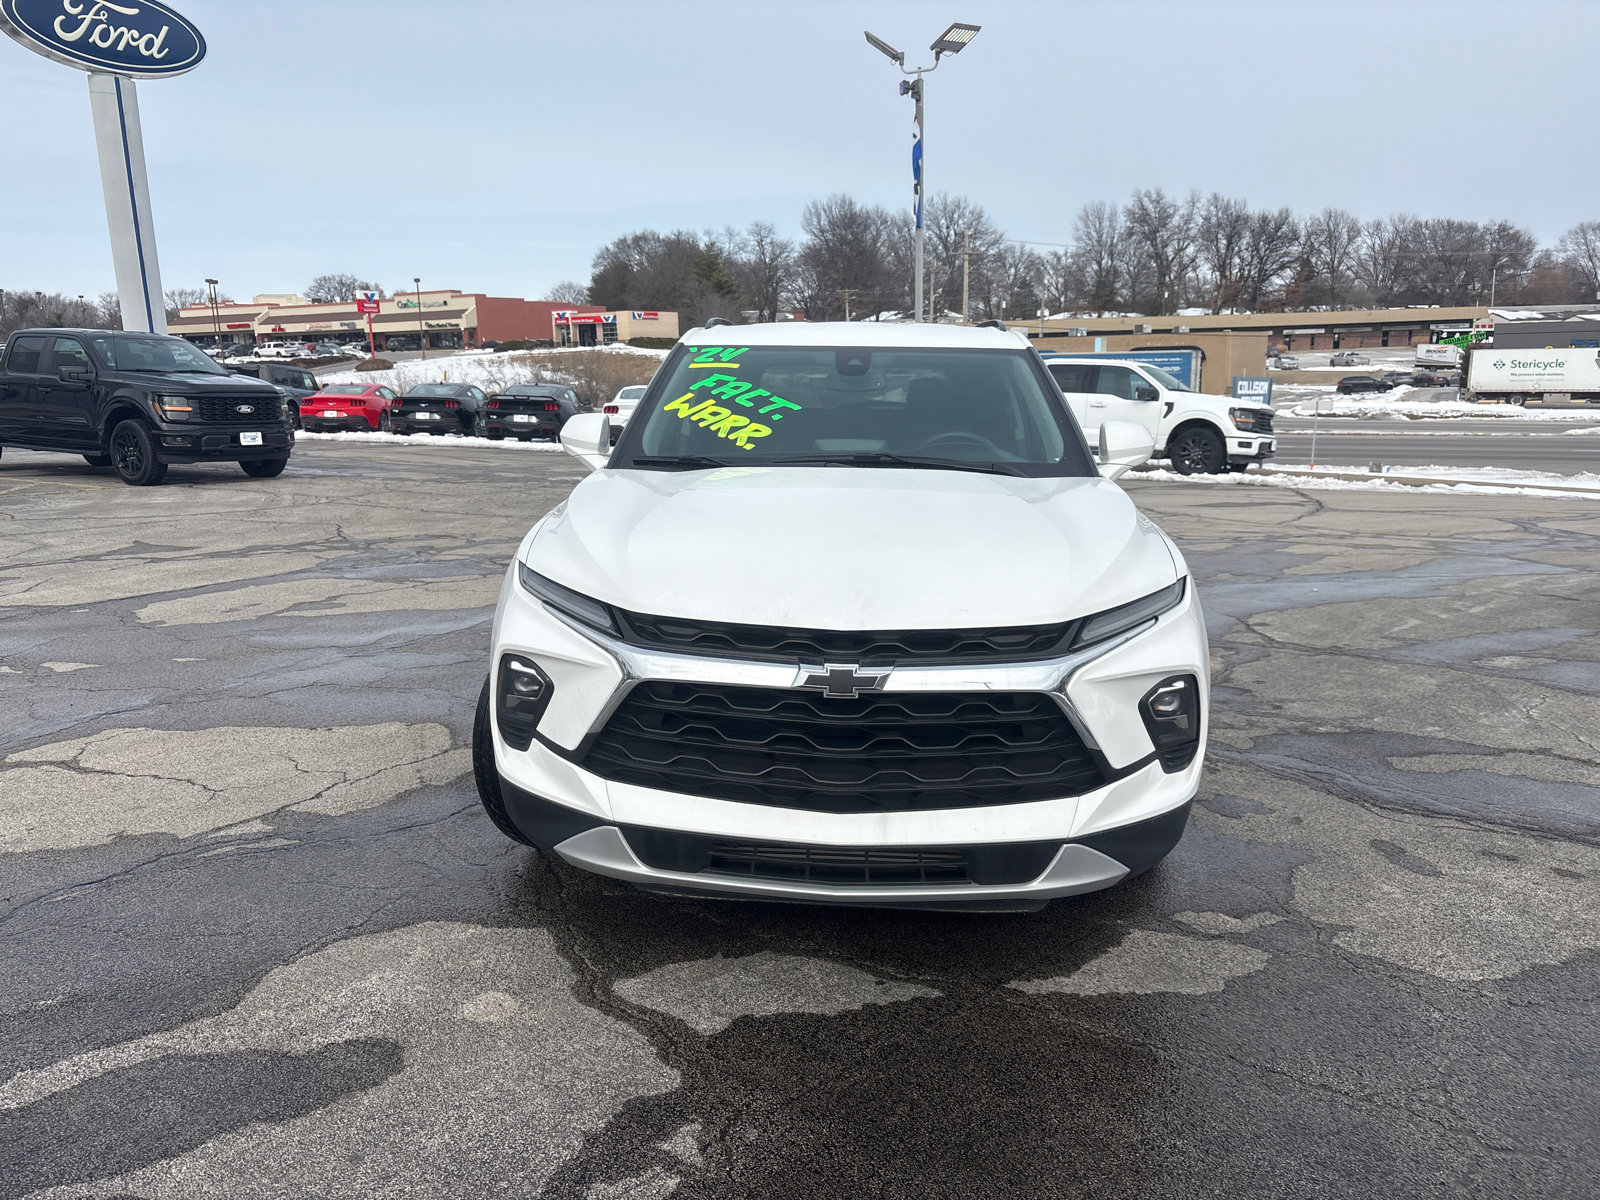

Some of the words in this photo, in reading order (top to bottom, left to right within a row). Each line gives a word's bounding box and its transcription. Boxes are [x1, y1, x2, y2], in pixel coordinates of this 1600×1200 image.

[53, 0, 170, 59] Ford
[1443, 334, 1469, 345] SQUARE
[1510, 358, 1565, 371] Stericycle
[689, 373, 802, 421] FACT.
[1237, 380, 1269, 395] COLLISION
[663, 392, 773, 451] WARR.
